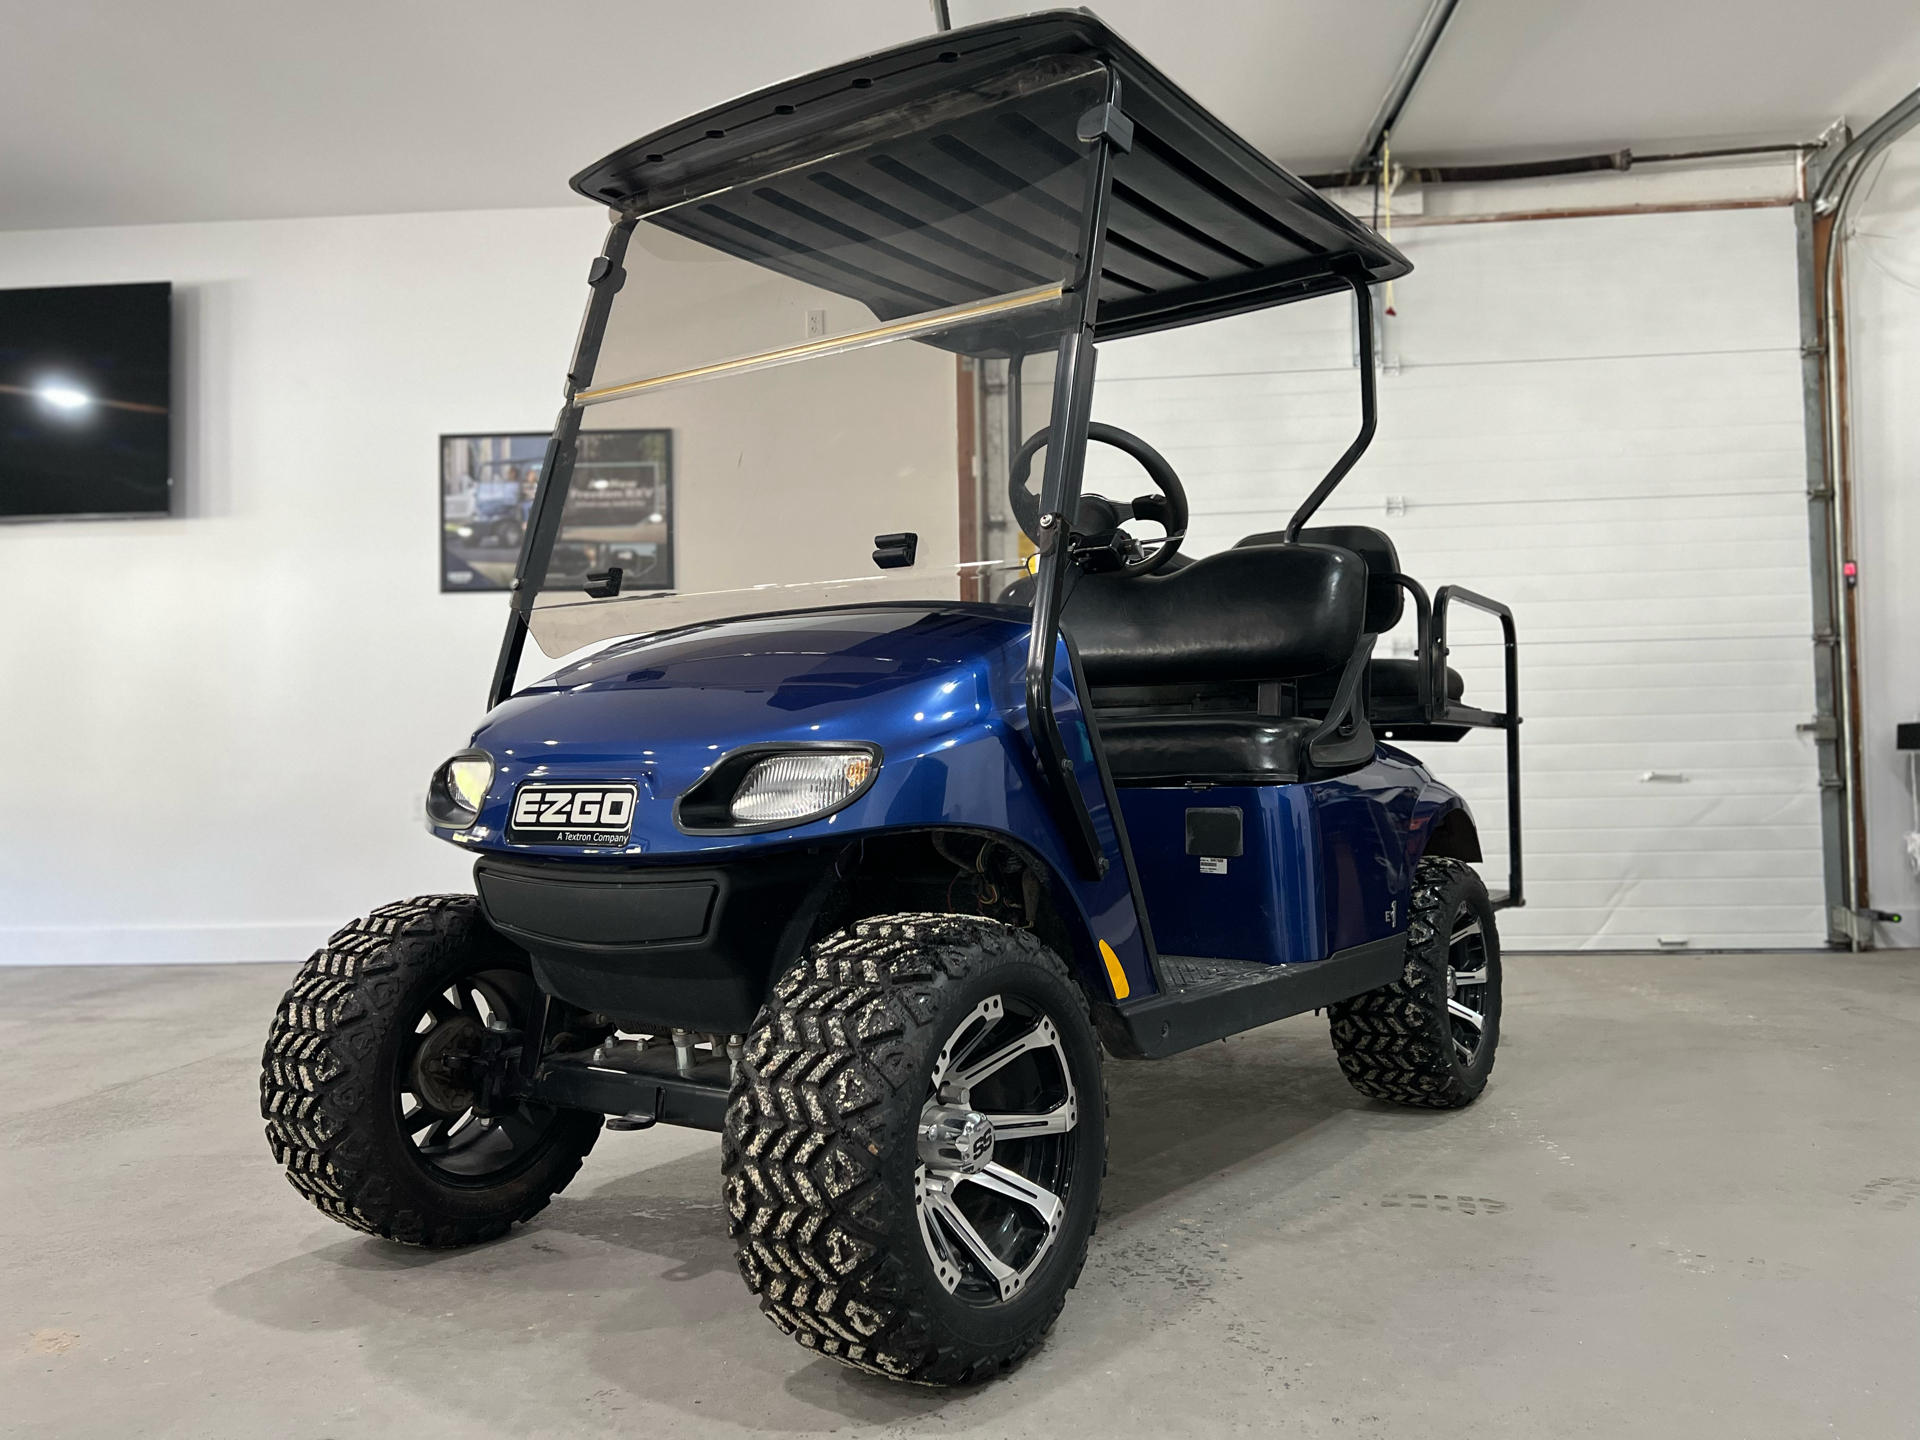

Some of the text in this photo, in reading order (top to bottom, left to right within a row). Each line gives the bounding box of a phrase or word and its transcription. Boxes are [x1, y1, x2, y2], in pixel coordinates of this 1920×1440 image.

[556, 832, 629, 844] A Textron Company
